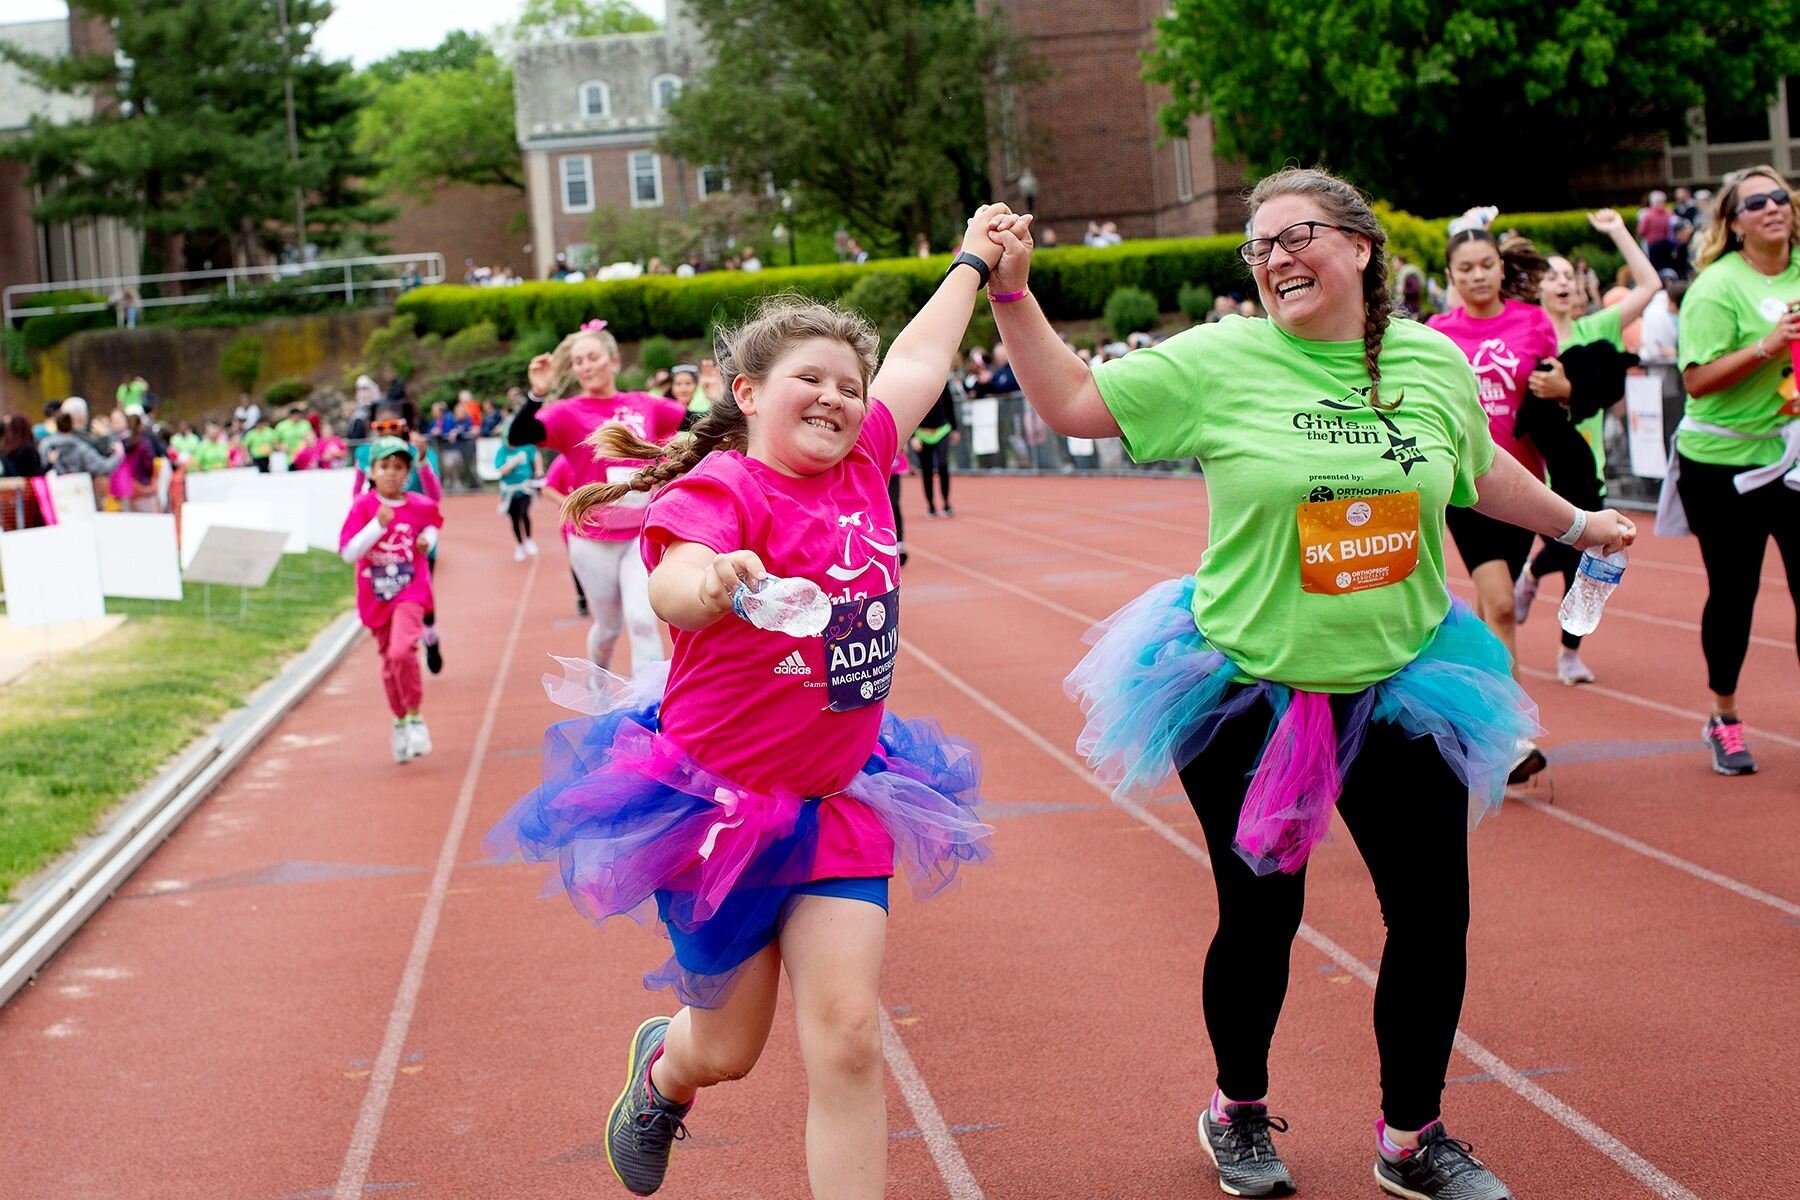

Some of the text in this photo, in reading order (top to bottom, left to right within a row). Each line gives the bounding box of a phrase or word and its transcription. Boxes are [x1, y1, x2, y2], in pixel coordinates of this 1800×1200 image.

[1292, 412, 1361, 430] Girls
[1306, 429, 1382, 444] the run
[1391, 443, 1422, 463] 5K
[1305, 530, 1417, 565] 5K BUDDY
[1352, 566, 1390, 577] ORTHOPEDIC
[774, 665, 812, 675] adidas
[831, 669, 872, 686] MAGICAL
